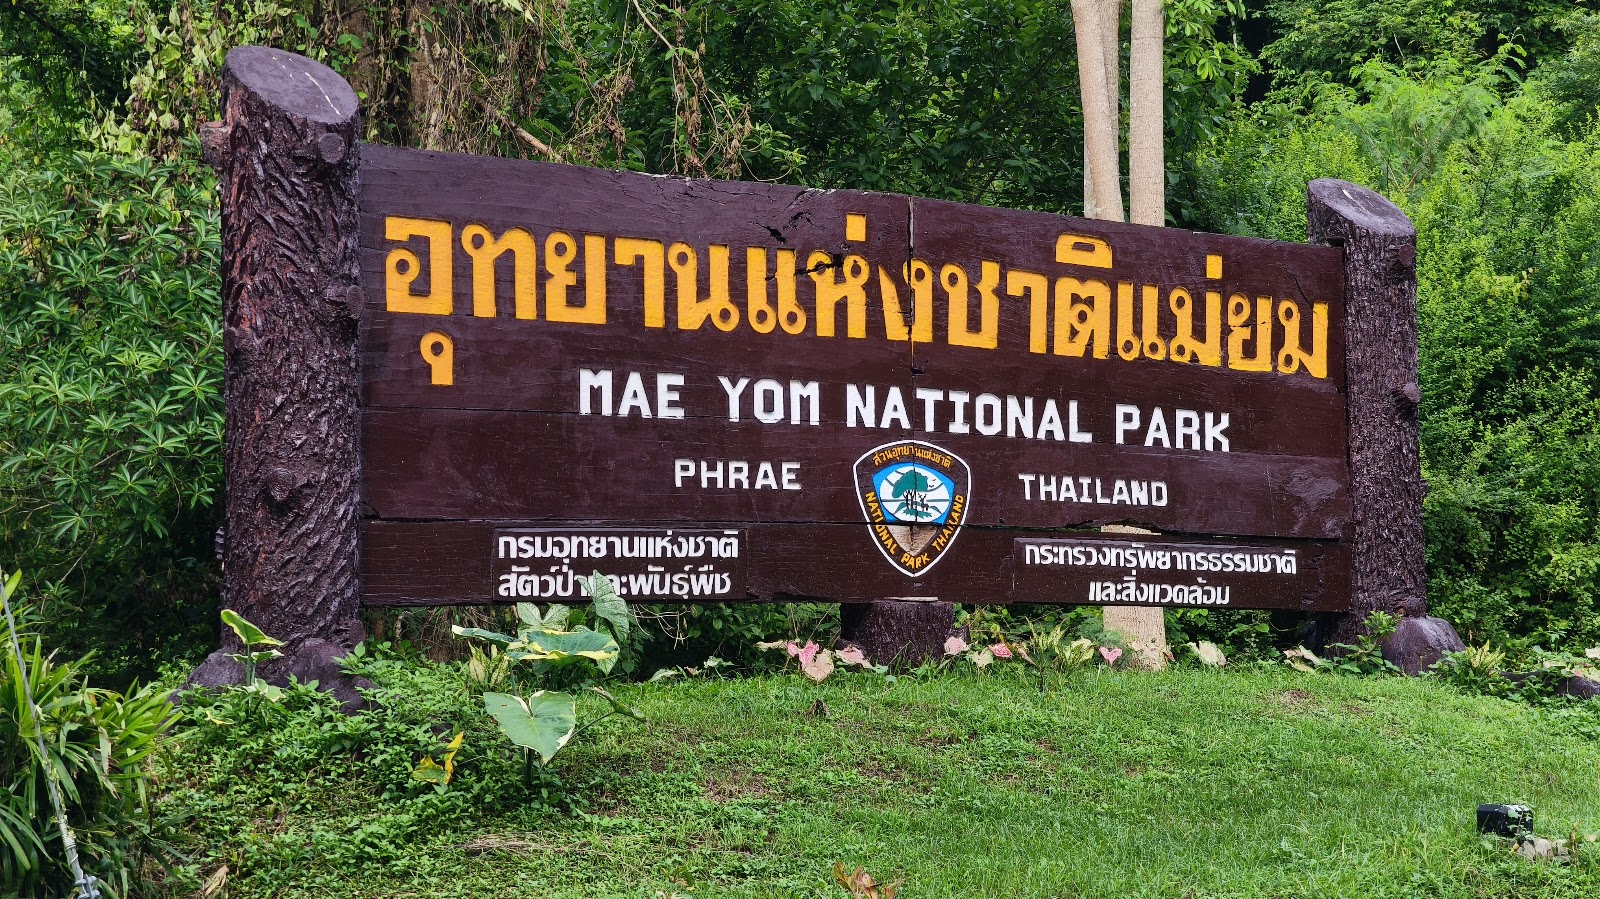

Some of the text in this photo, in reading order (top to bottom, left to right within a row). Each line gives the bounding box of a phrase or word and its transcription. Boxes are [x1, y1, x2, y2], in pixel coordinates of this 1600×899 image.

[384, 212, 1329, 387] อุทยานแห่งชาติแม่ยม
[579, 368, 1230, 452] MAE YOM NATIONAL PARK
[674, 458, 801, 490] PHRAE
[1018, 472, 1168, 507] THAILAND
[498, 530, 739, 564] กรมอุทยานแห่งชาติ
[865, 491, 964, 569] NATIONAL PARK THAILAND
[1025, 542, 1297, 575] กระทรวงทรัพยากรธรรมชาติ
[1089, 569, 1230, 605] และสิ่งแวดล้อม
